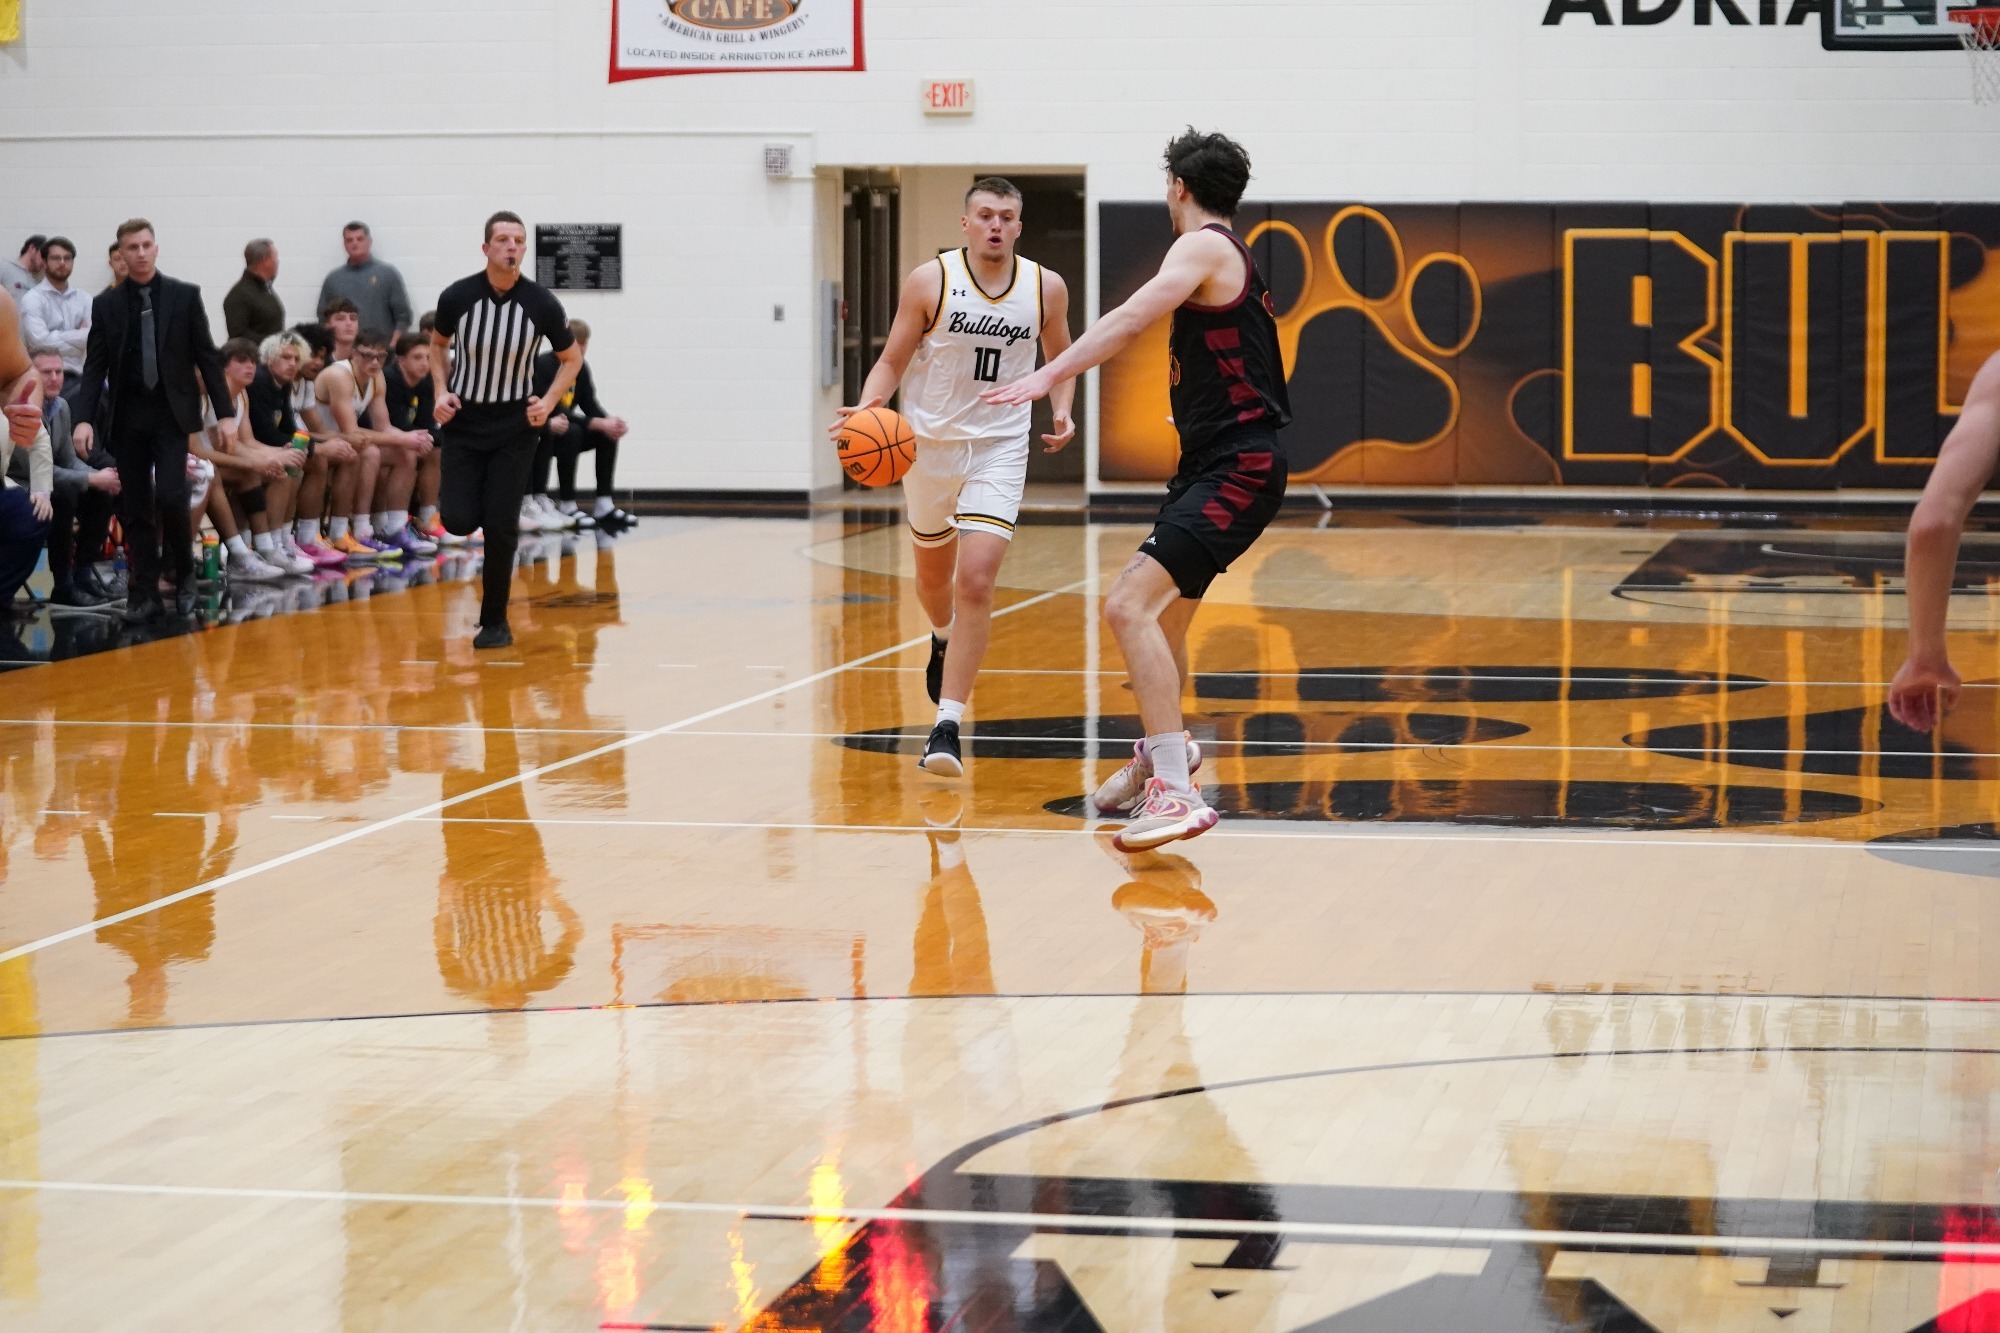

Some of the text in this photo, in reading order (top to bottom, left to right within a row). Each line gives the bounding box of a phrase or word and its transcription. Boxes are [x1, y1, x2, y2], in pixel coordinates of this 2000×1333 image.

[690, 0, 774, 20] CAFE
[661, 16, 805, 43] AMERICAN GRILL & WINGERY
[627, 47, 848, 61] LOCATED INSIDE ARRINGTON ICE ARENA
[932, 82, 964, 107] EXIT
[948, 311, 1031, 346] Bulldogs
[973, 346, 1002, 382] 10
